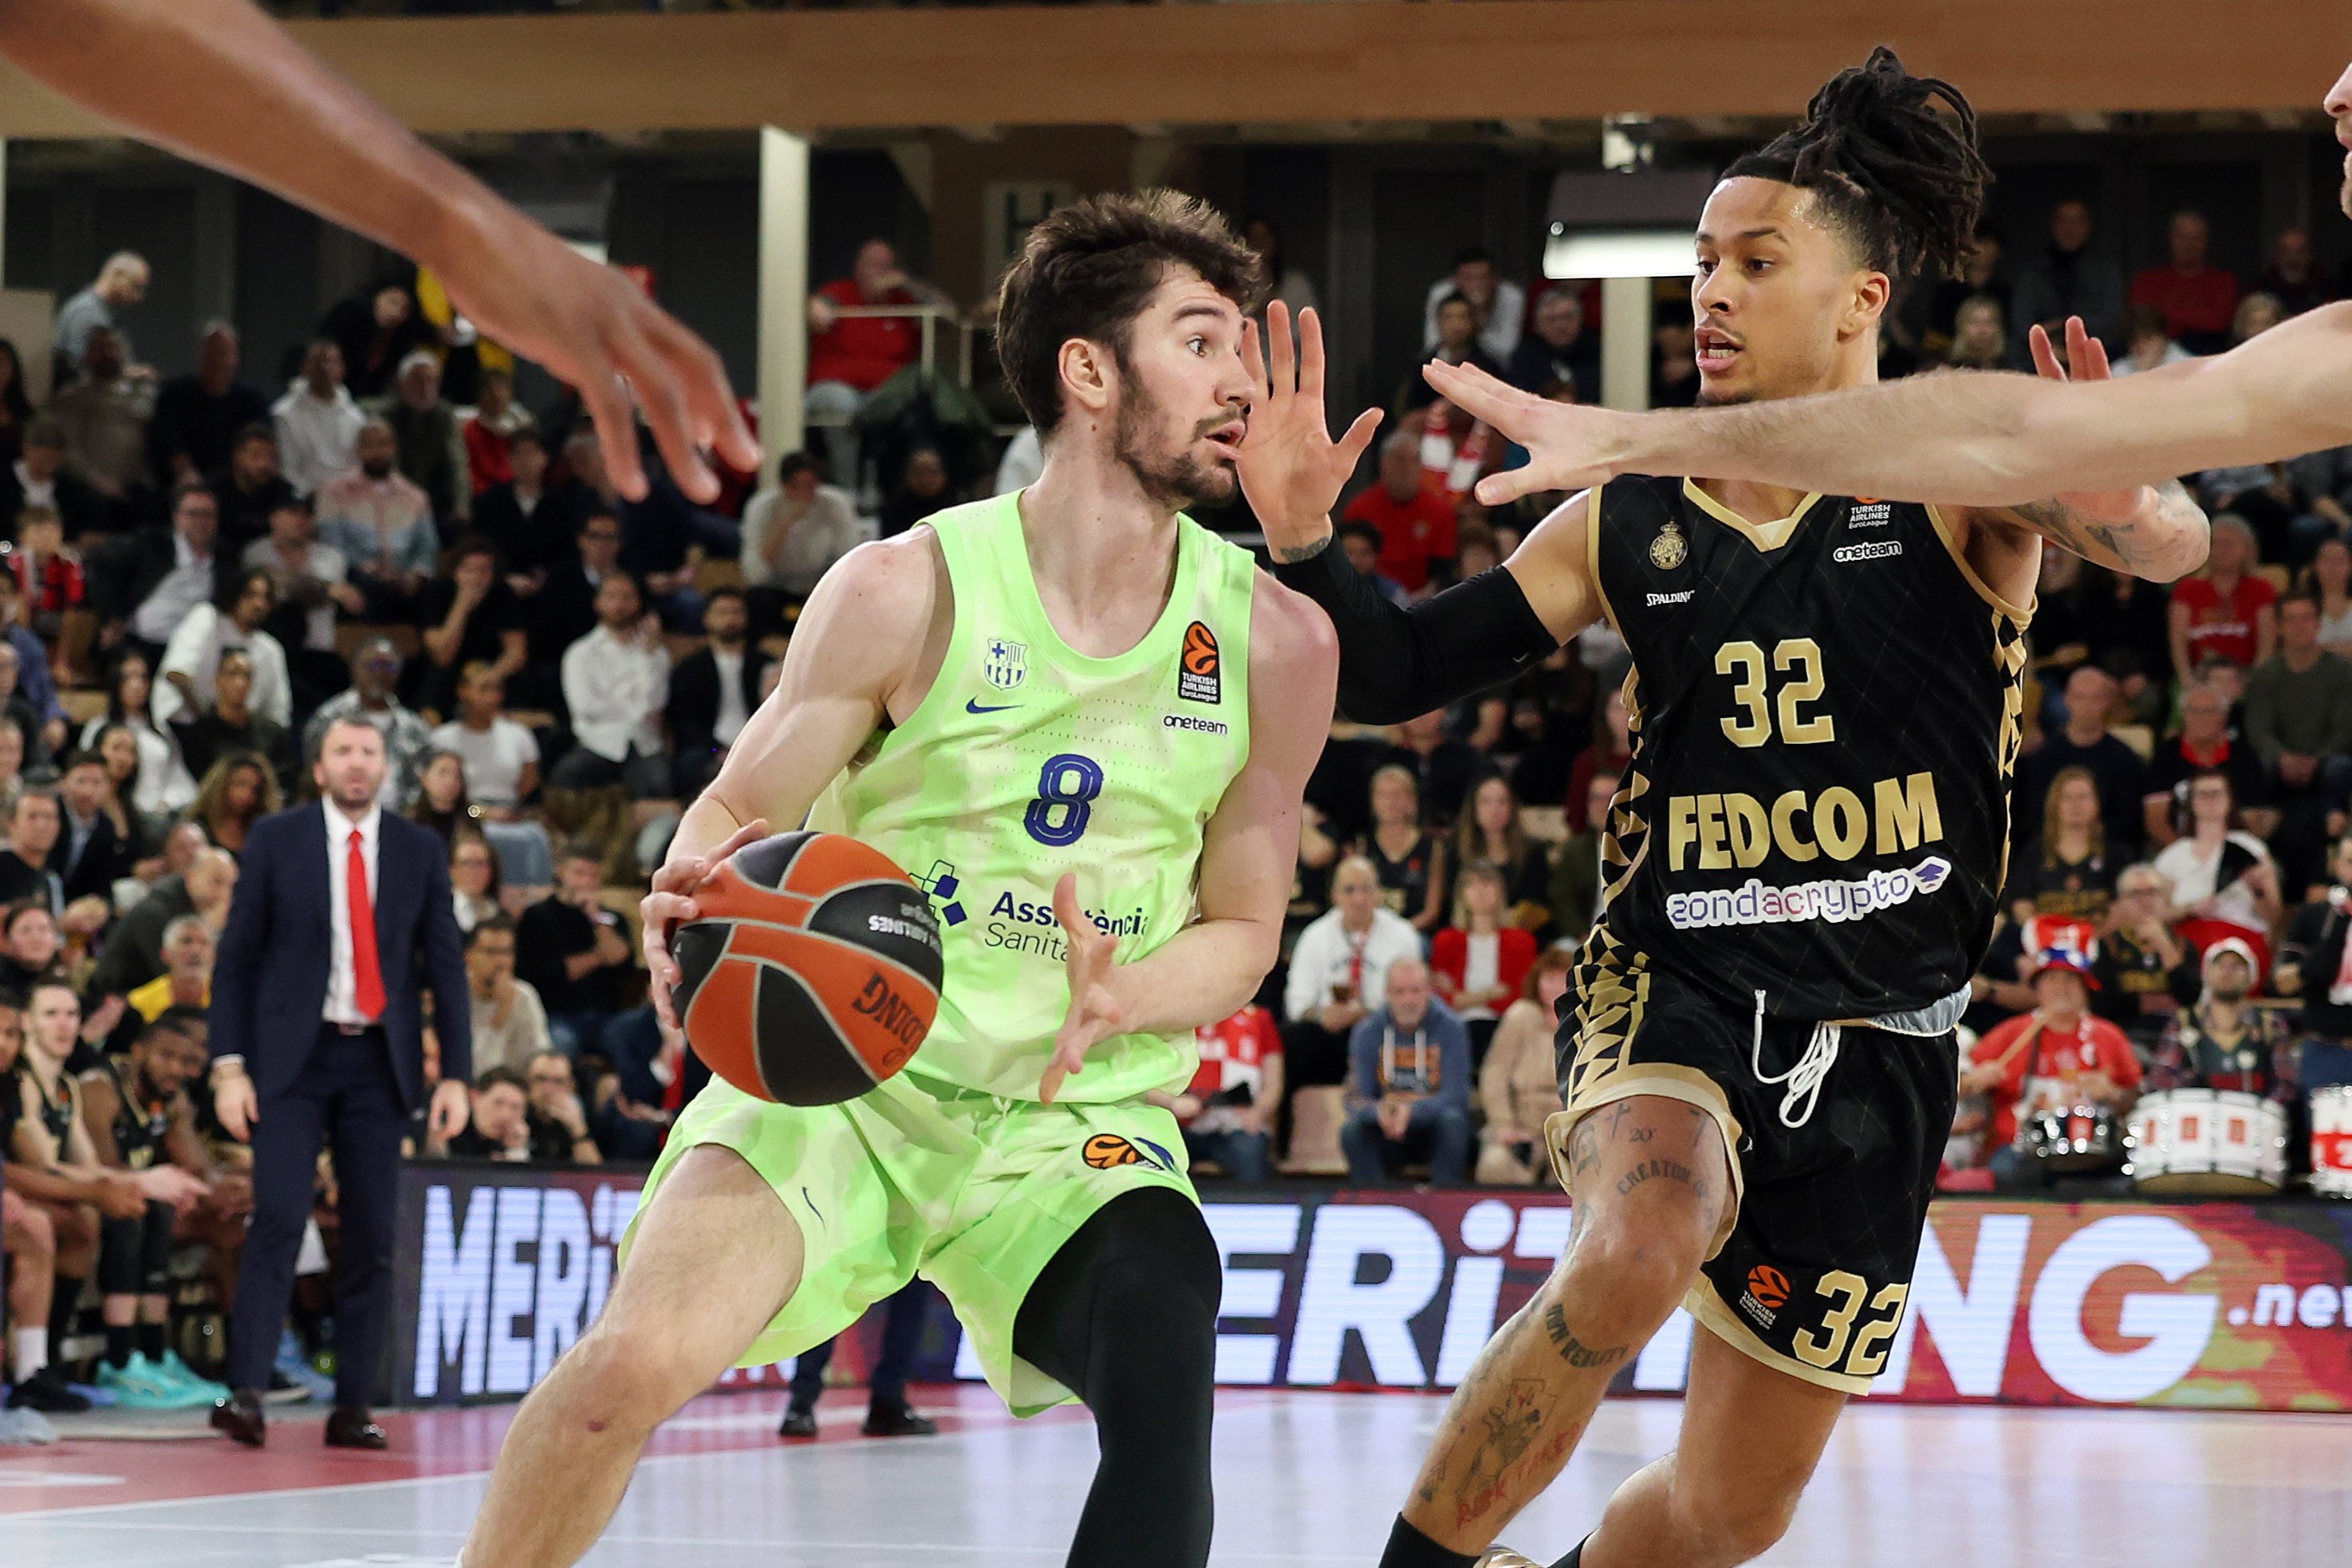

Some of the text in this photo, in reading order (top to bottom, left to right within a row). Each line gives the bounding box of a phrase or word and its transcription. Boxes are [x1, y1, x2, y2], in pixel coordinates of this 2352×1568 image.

[1850, 504, 1890, 514] TURKISH
[1850, 512, 1889, 522] AIRLINES
[1834, 542, 1902, 561] oneteam
[1181, 681, 1217, 695] AIRLINES
[1182, 672, 1217, 686] TURKISH
[1715, 638, 1835, 747] 32
[1163, 715, 1228, 735] oneteam
[1023, 754, 1105, 847] 8
[1668, 771, 1943, 871] FEDCOM
[1670, 873, 1909, 923] zondacrypto
[1792, 1269, 1909, 1375] 32
